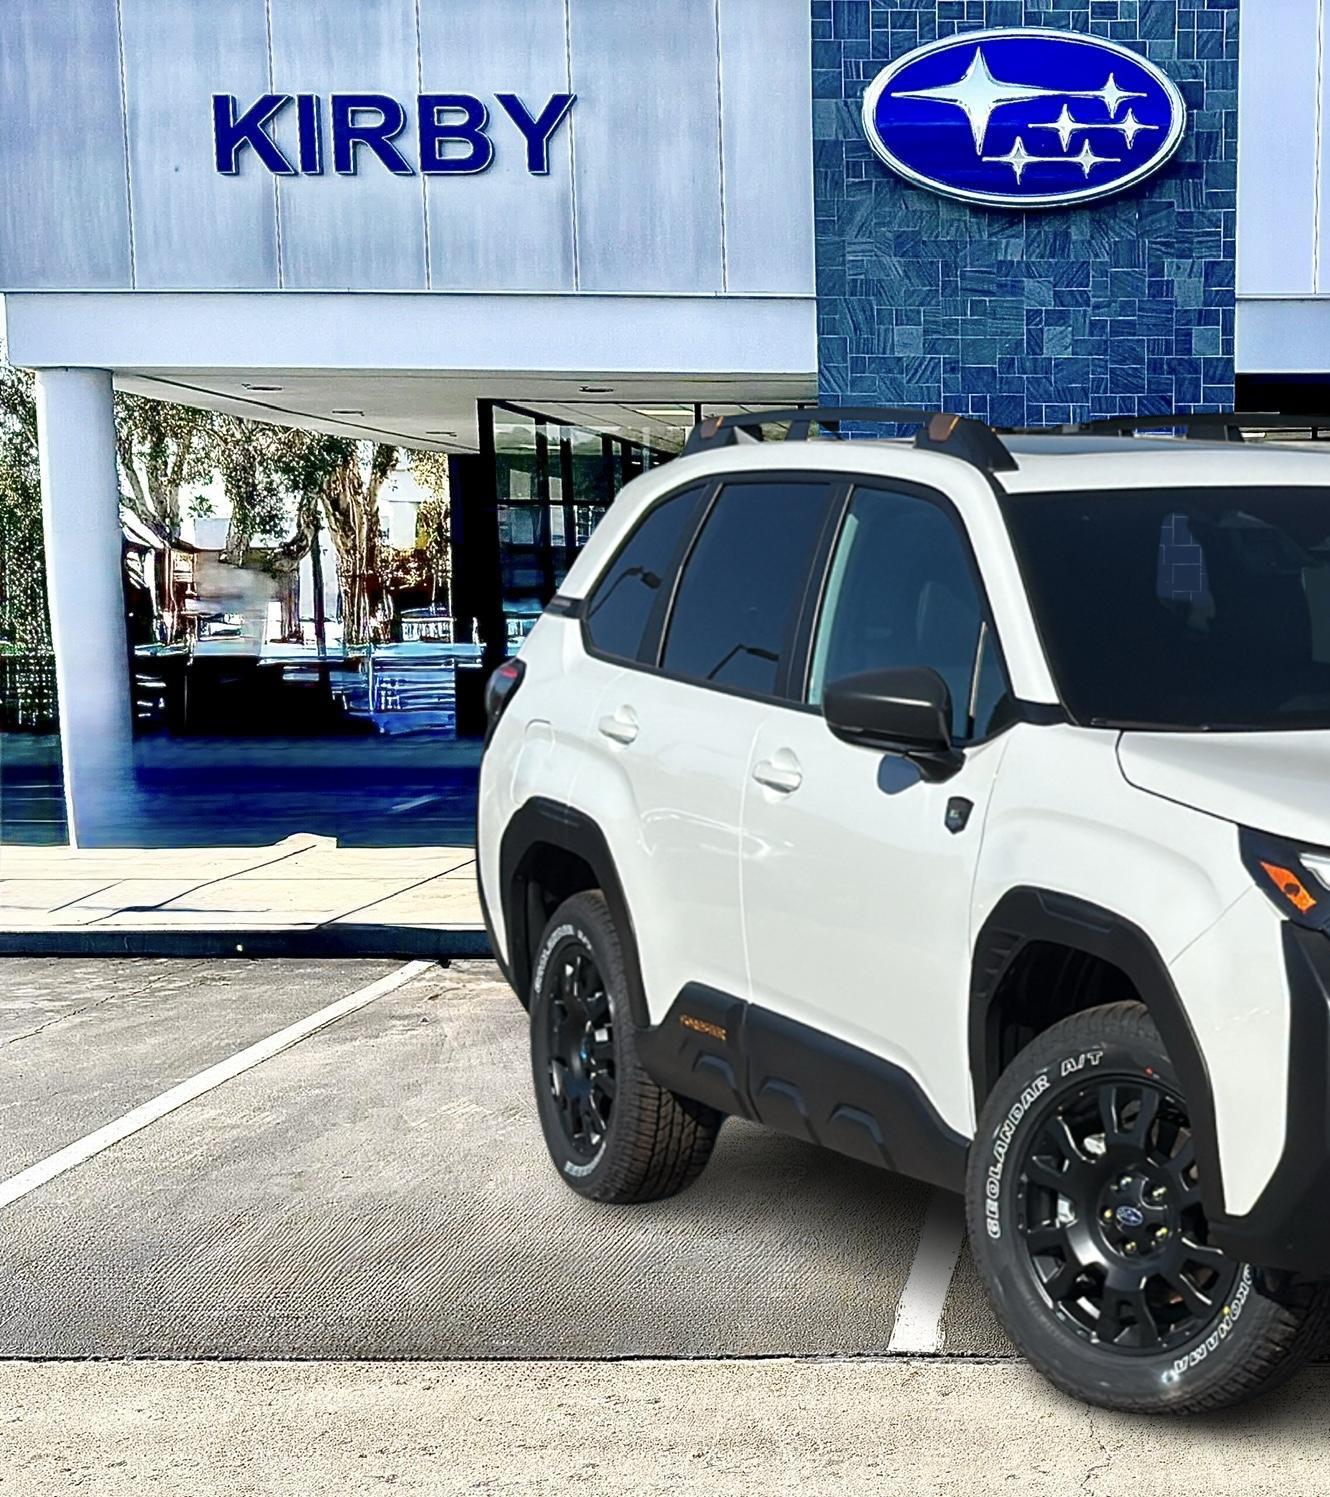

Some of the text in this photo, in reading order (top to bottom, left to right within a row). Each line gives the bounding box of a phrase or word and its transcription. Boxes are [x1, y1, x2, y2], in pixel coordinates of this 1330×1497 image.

[212, 93, 577, 175] KIRBY
[986, 1050, 1104, 1239] GEOLANDAR A/T
[1174, 1263, 1254, 1374] OKOHAMA
